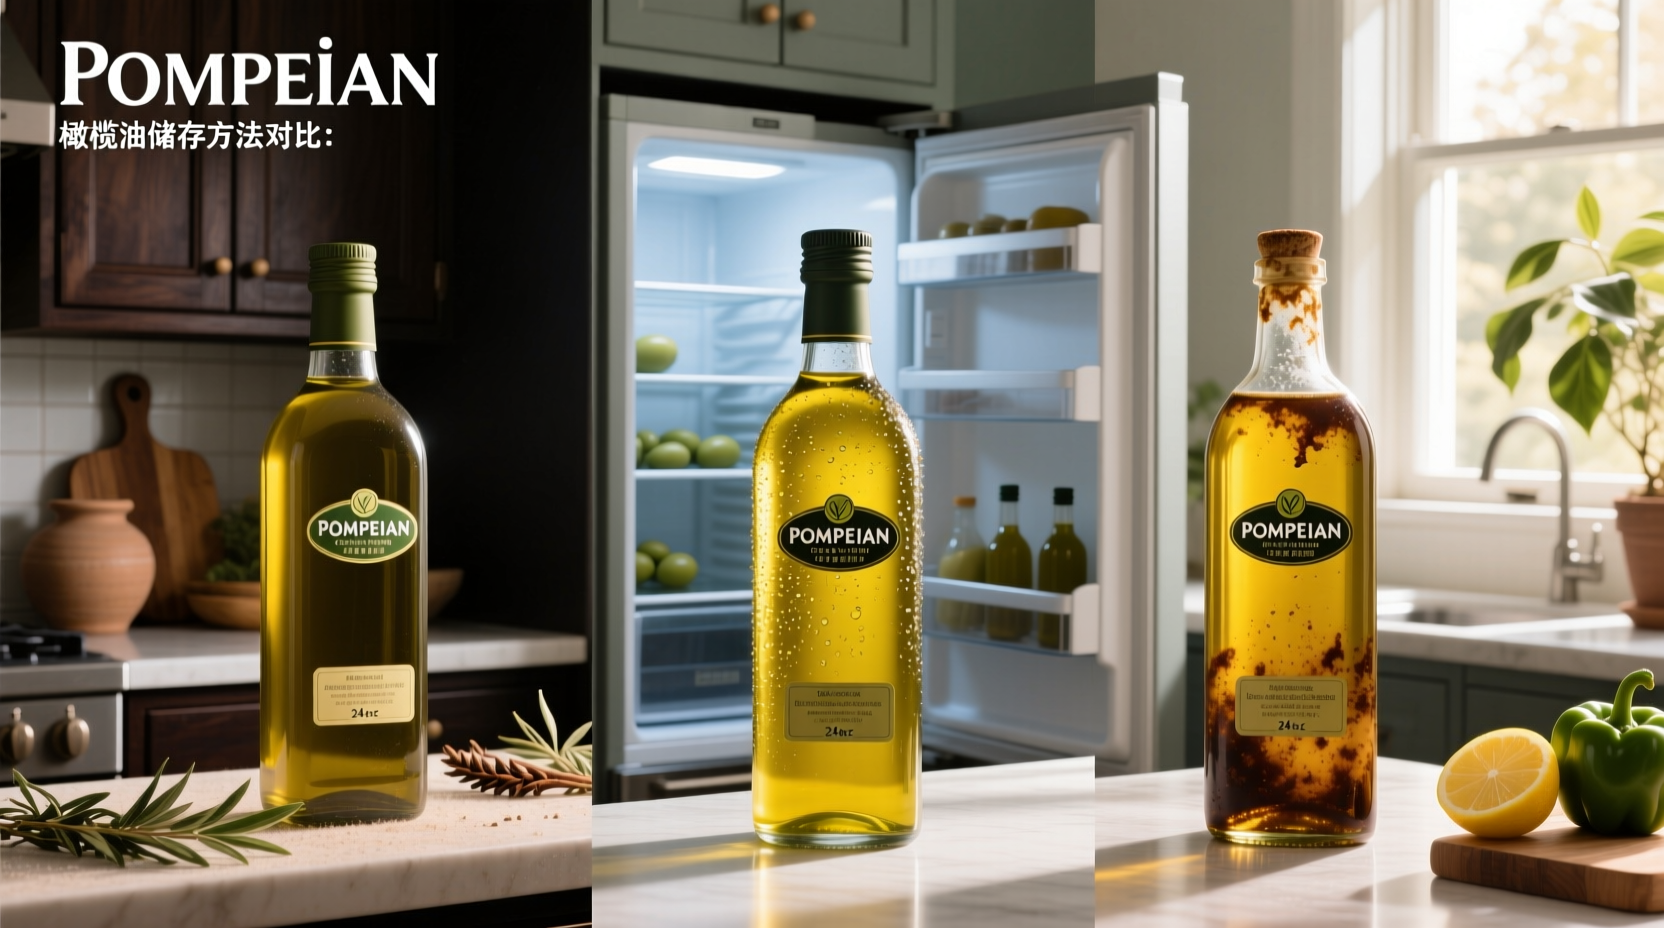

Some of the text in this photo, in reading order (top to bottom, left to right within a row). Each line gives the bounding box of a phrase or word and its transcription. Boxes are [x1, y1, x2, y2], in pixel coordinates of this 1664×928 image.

[318, 520, 410, 537] POMPEIAN
[789, 526, 889, 545] POMPEIAN
[1241, 521, 1341, 539] POMPEIAN
